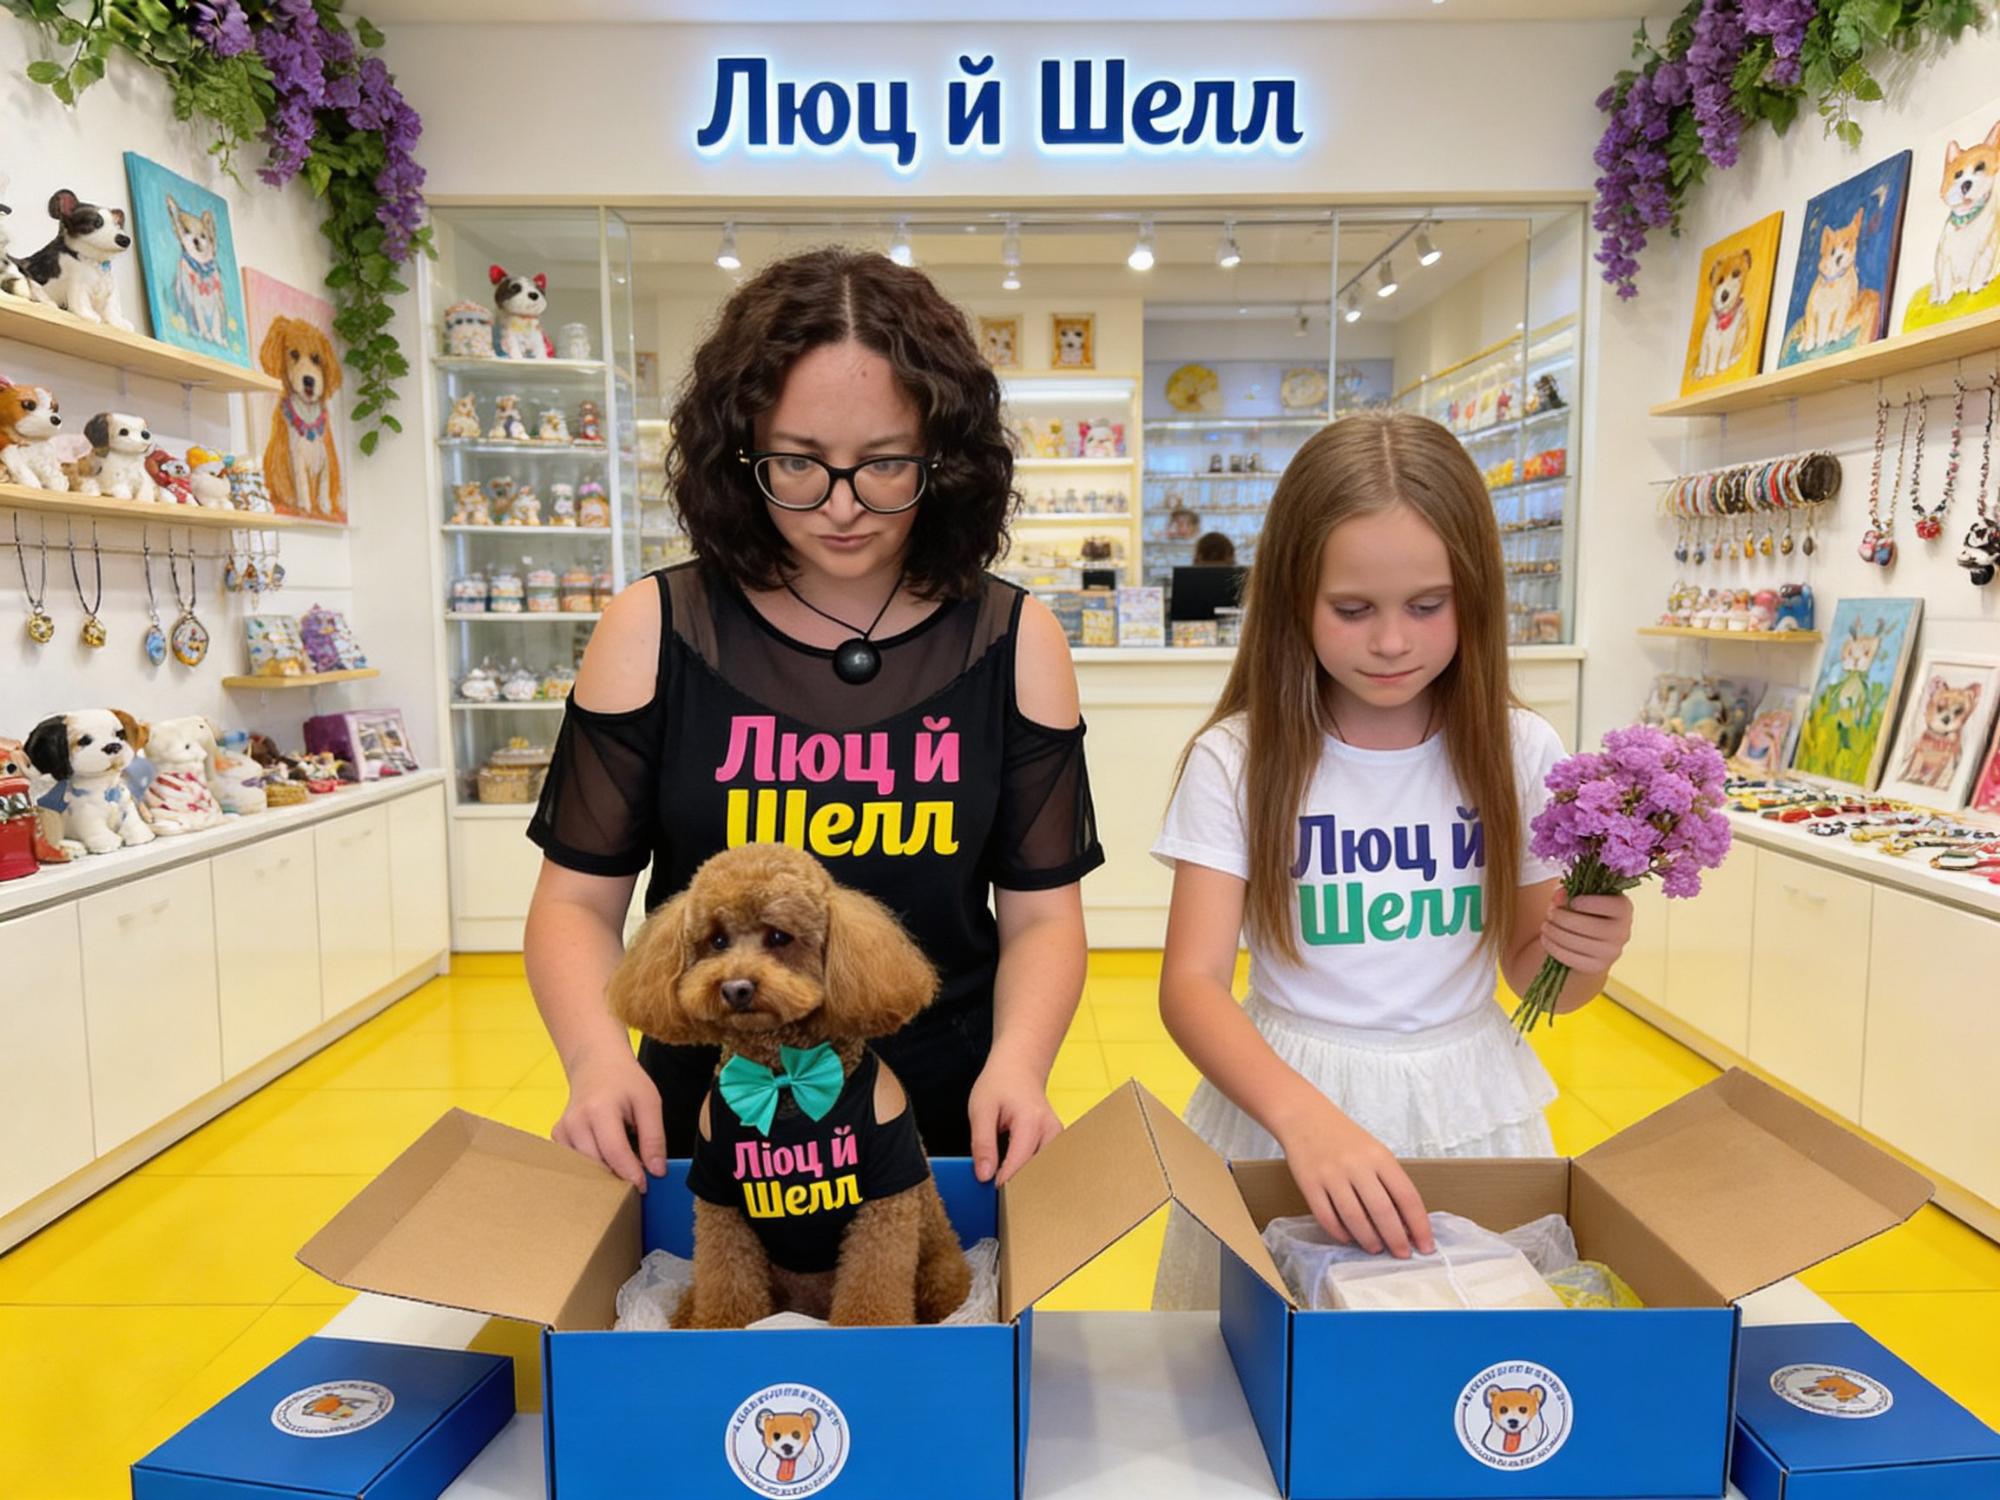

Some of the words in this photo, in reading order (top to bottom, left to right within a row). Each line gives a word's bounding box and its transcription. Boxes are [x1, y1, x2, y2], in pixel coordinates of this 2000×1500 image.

[696, 57, 917, 166] Люц
[948, 54, 1001, 146] й
[1041, 59, 1304, 146] Шелл
[714, 715, 896, 796] Люц
[726, 788, 960, 857] Шелл
[1289, 814, 1437, 882] Люц
[1297, 882, 1486, 946] Шелл
[742, 1173, 864, 1219] Шелл
